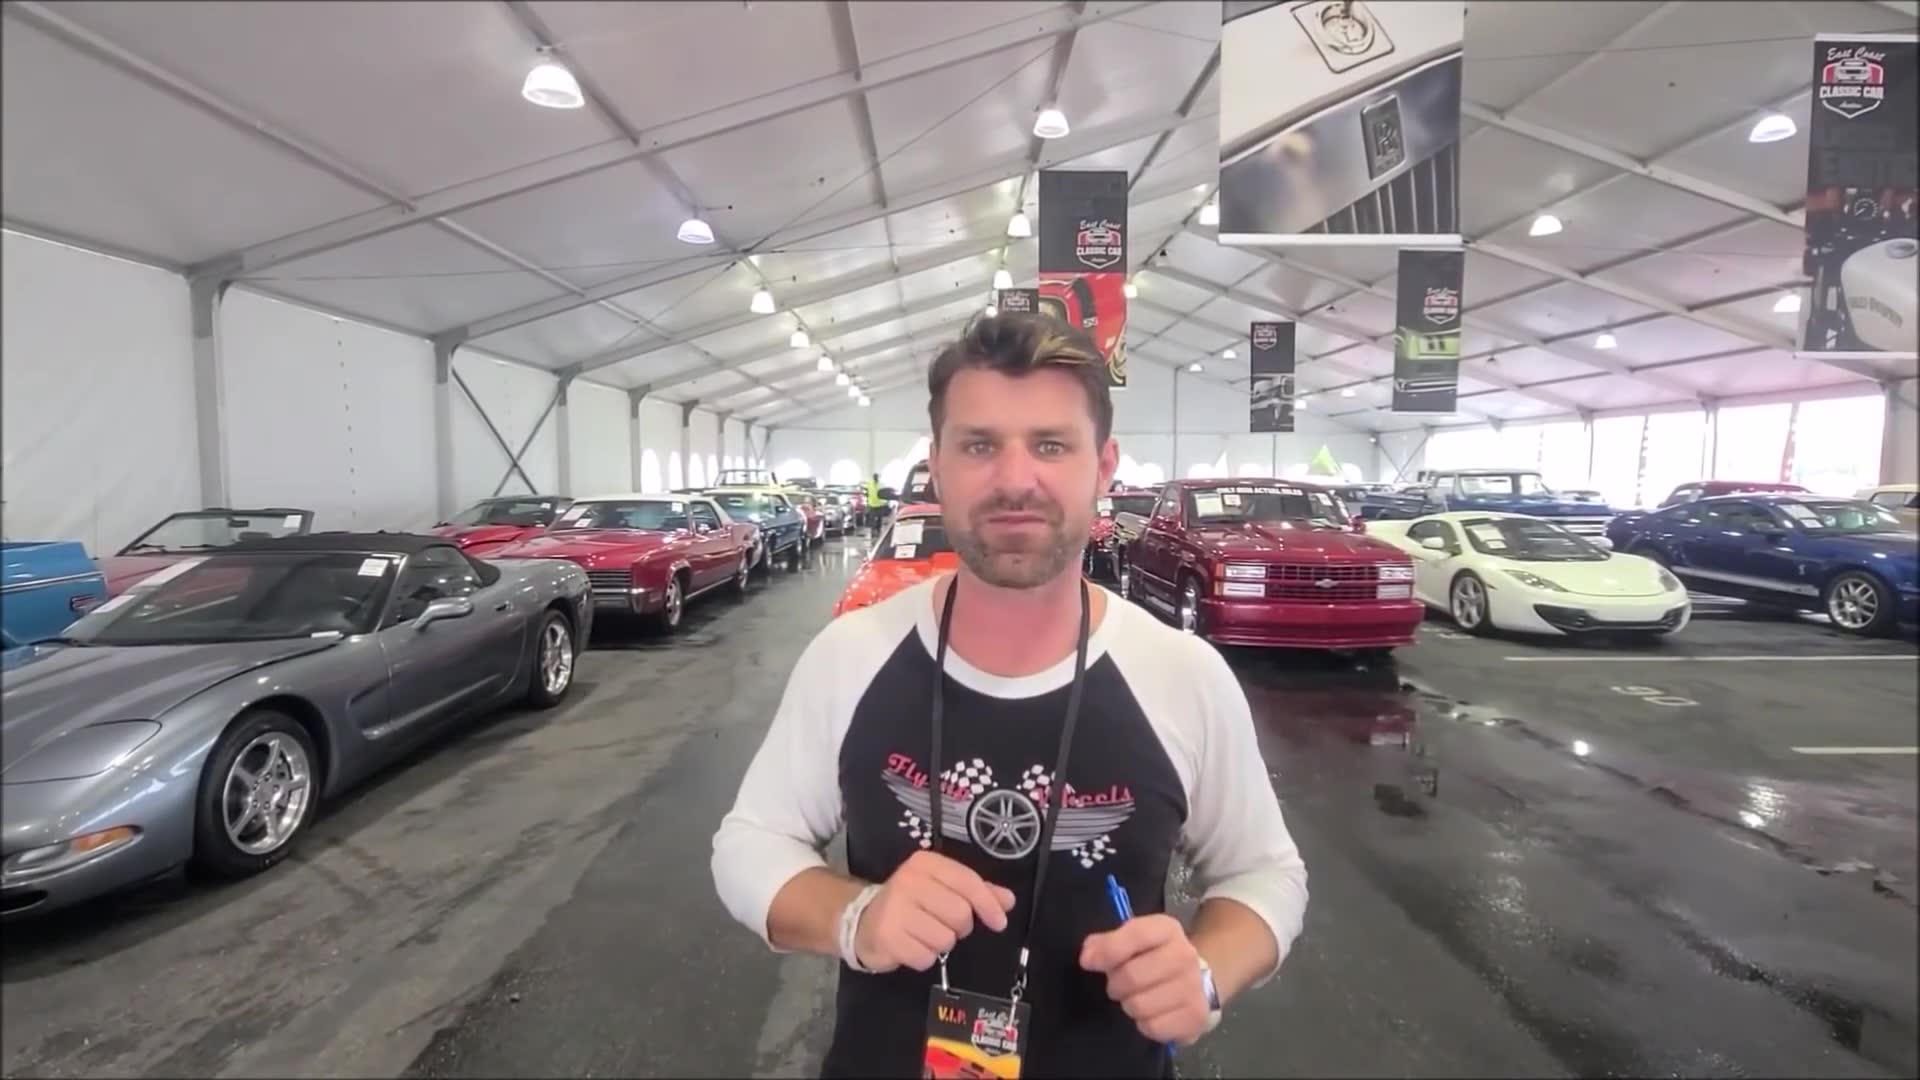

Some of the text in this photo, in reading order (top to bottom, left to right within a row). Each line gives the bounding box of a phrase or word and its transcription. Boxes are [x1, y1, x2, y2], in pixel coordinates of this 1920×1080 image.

[1827, 46, 1886, 61] East Coast
[1820, 85, 1884, 99] CLASSIC CAR
[938, 1005, 967, 1025] V.I.P.
